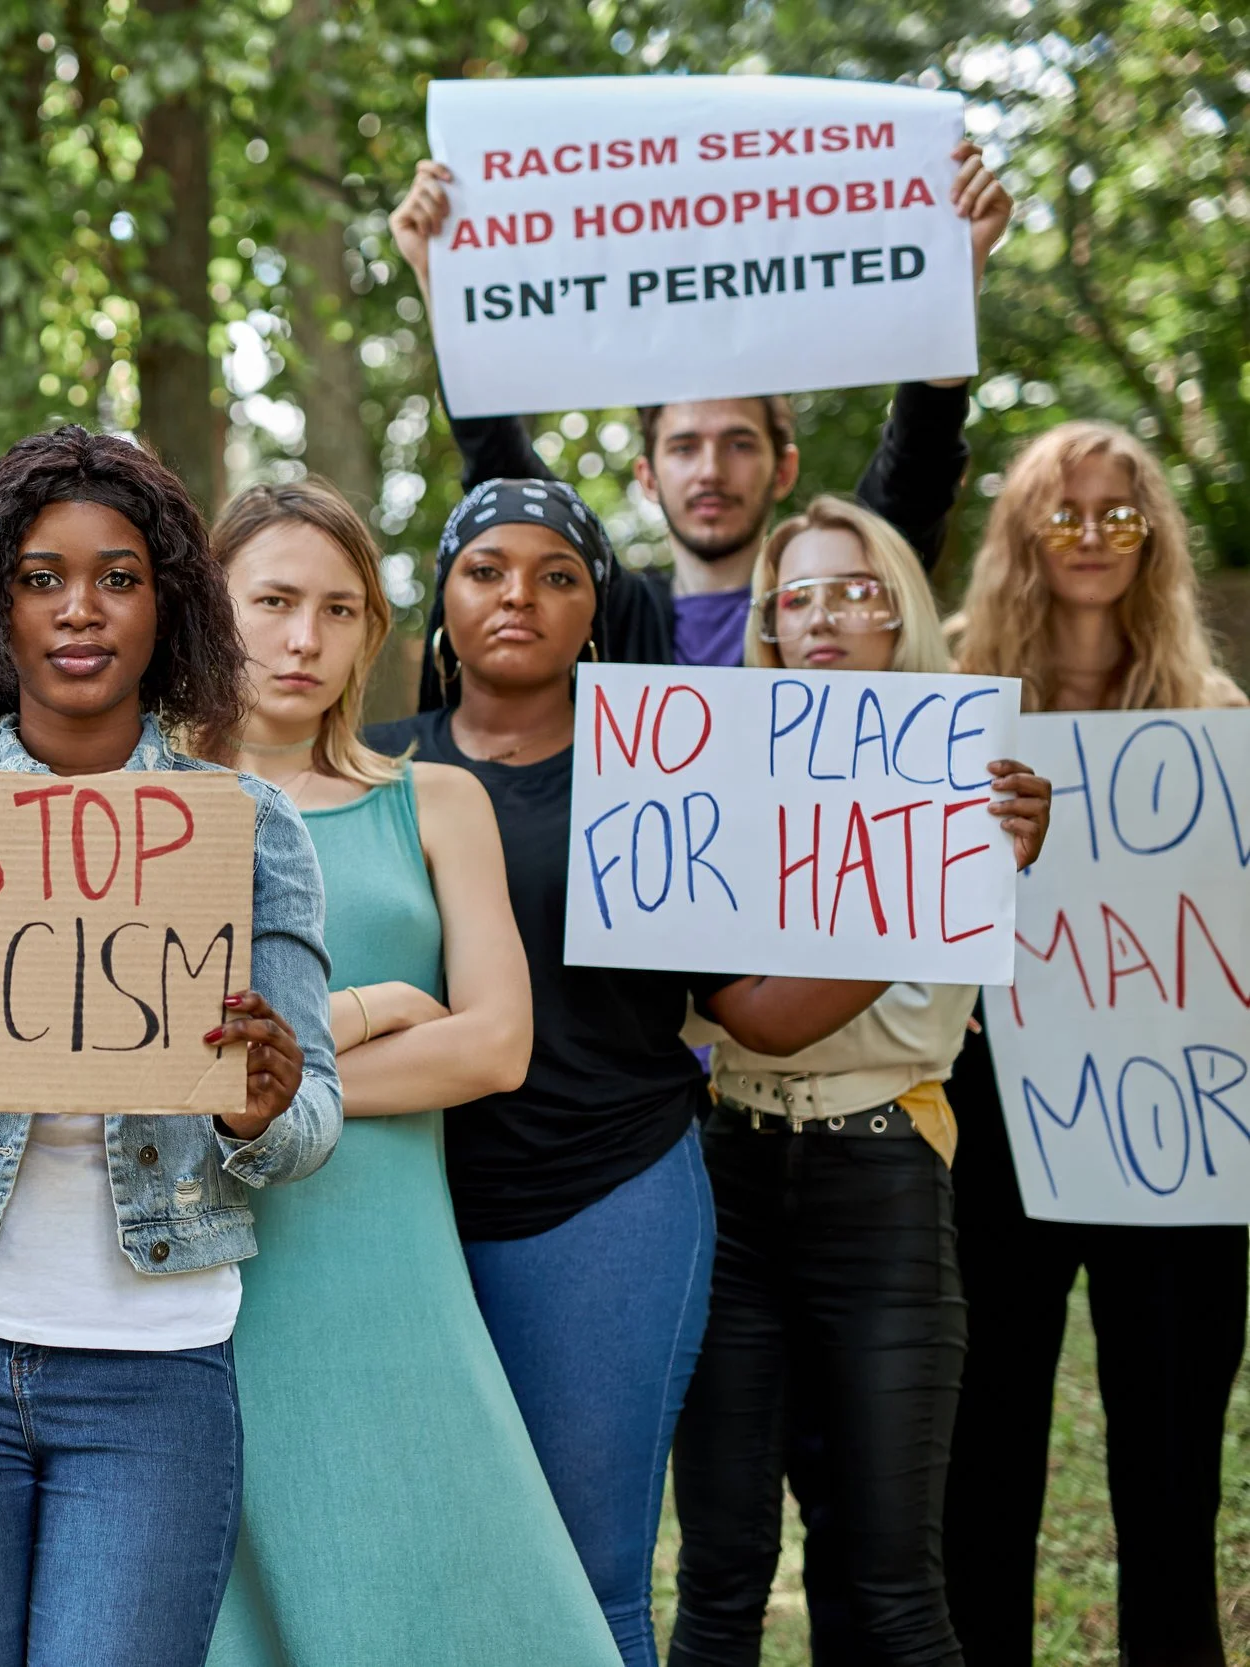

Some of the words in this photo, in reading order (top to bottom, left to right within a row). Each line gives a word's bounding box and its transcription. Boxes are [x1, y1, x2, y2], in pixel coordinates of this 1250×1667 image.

[482, 136, 679, 181] RACISM
[697, 121, 896, 162] SEXISM
[450, 210, 555, 251] AND
[573, 176, 936, 239] HOMOPHOBIA
[628, 244, 927, 308] PERMITED
[594, 684, 712, 776] NO
[768, 679, 1000, 791] PLACE
[584, 791, 739, 931] FOR
[778, 797, 995, 944] HATE
